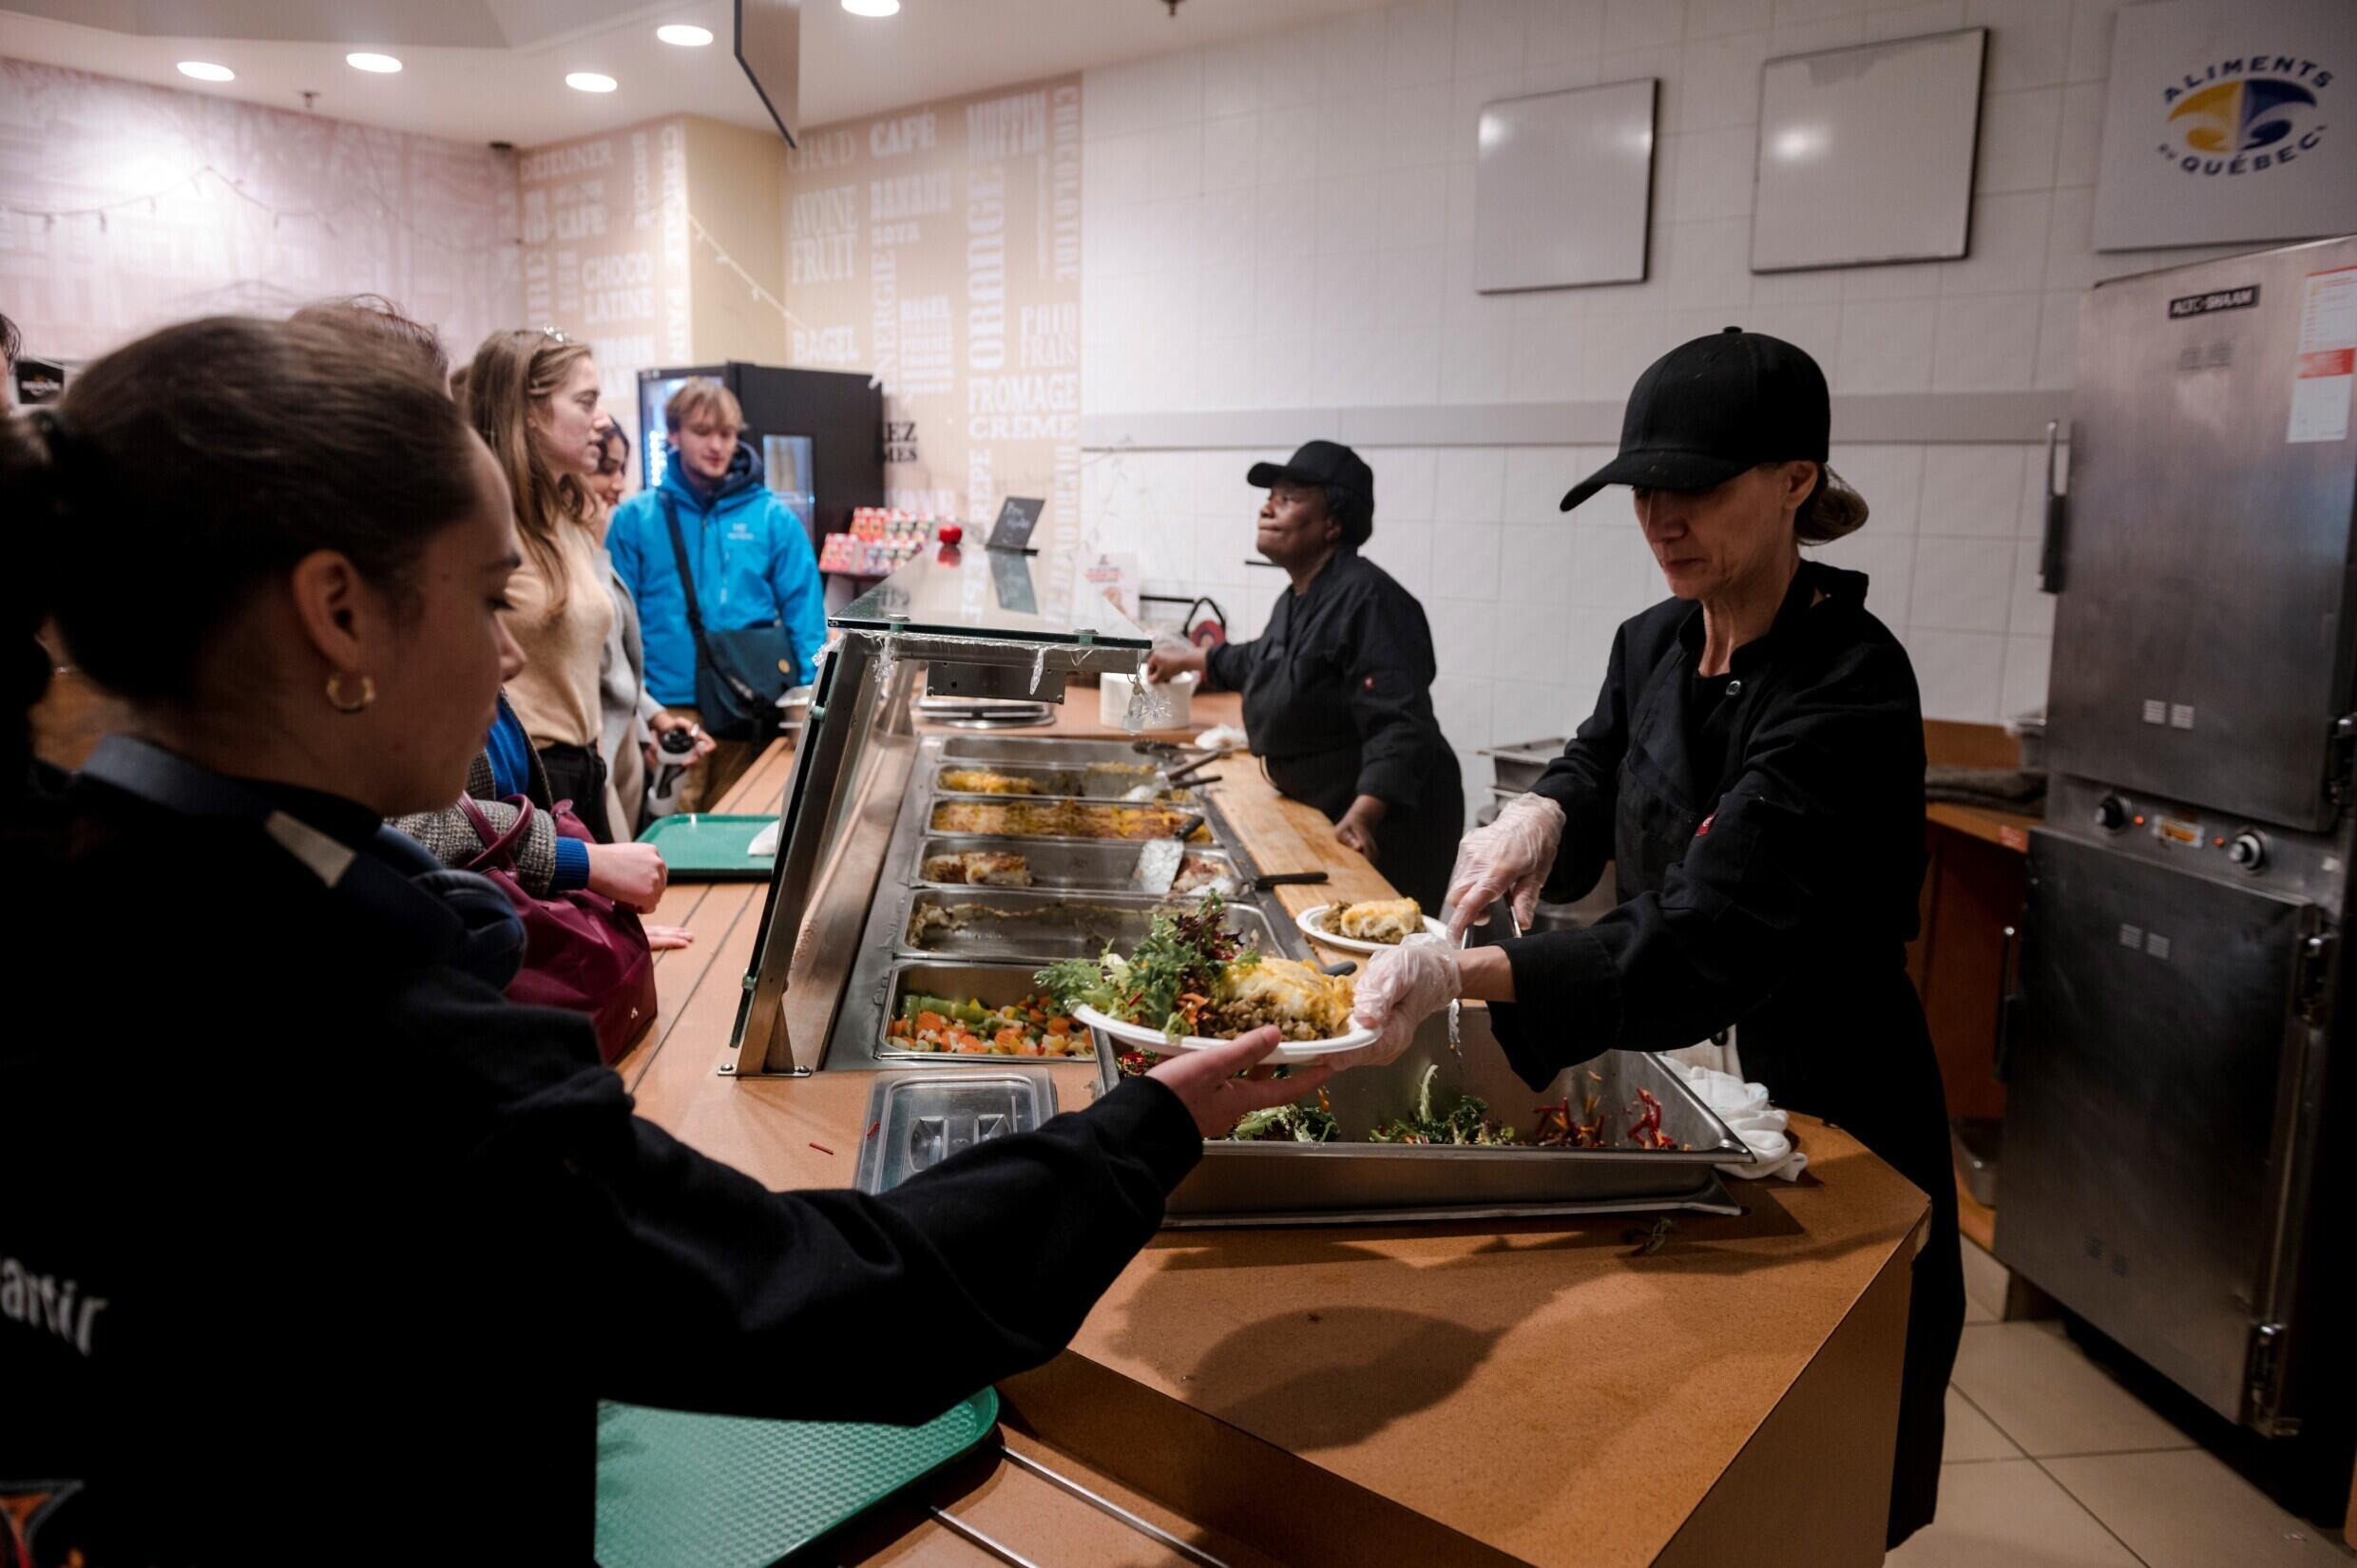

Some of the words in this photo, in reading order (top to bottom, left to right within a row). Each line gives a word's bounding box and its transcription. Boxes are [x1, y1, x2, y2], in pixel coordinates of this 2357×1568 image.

[2165, 55, 2333, 105] ALIMENTS
[2180, 129, 2322, 176] QUÉBEC
[582, 251, 653, 290] CHOCO
[791, 234, 858, 284] FRUIT
[968, 373, 1079, 412] FROMAGE
